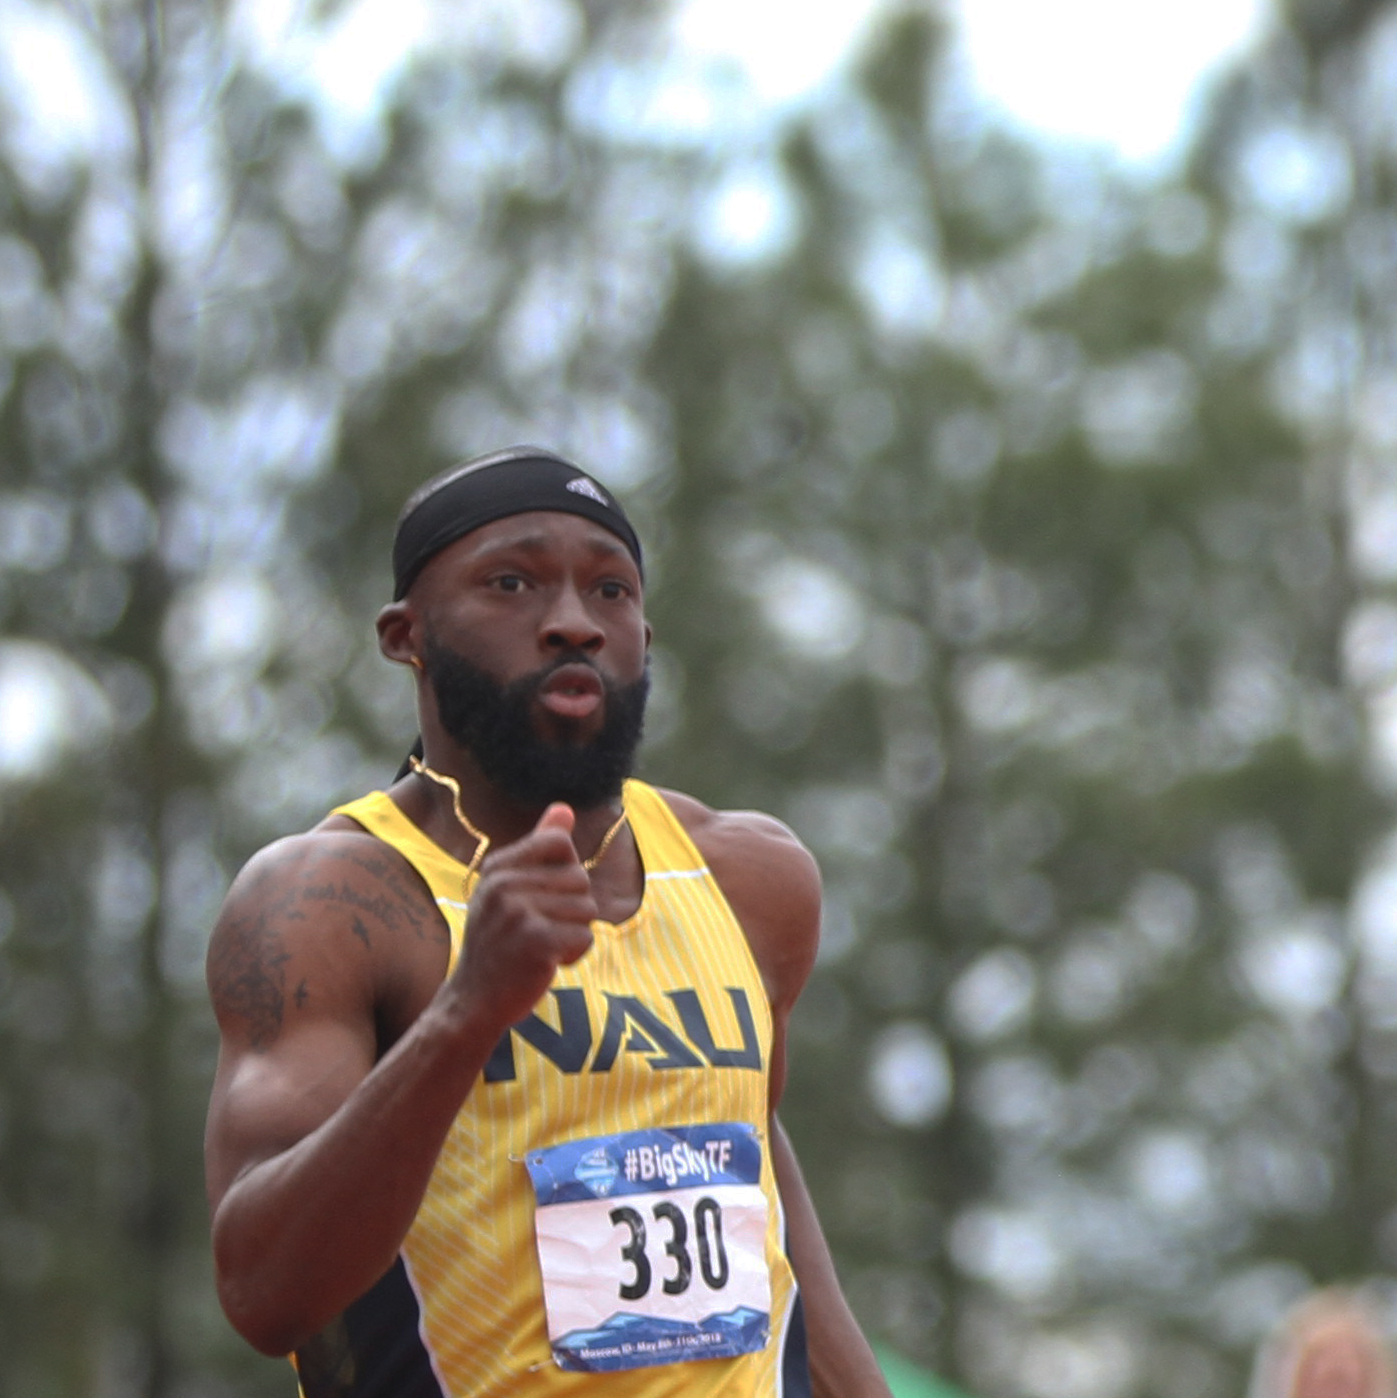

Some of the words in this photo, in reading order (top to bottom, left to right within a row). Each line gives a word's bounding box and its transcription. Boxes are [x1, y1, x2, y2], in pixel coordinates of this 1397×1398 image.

[483, 987, 762, 1084] NAU
[624, 1140, 731, 1186] #BigSkyTF
[609, 1197, 729, 1301] 330
